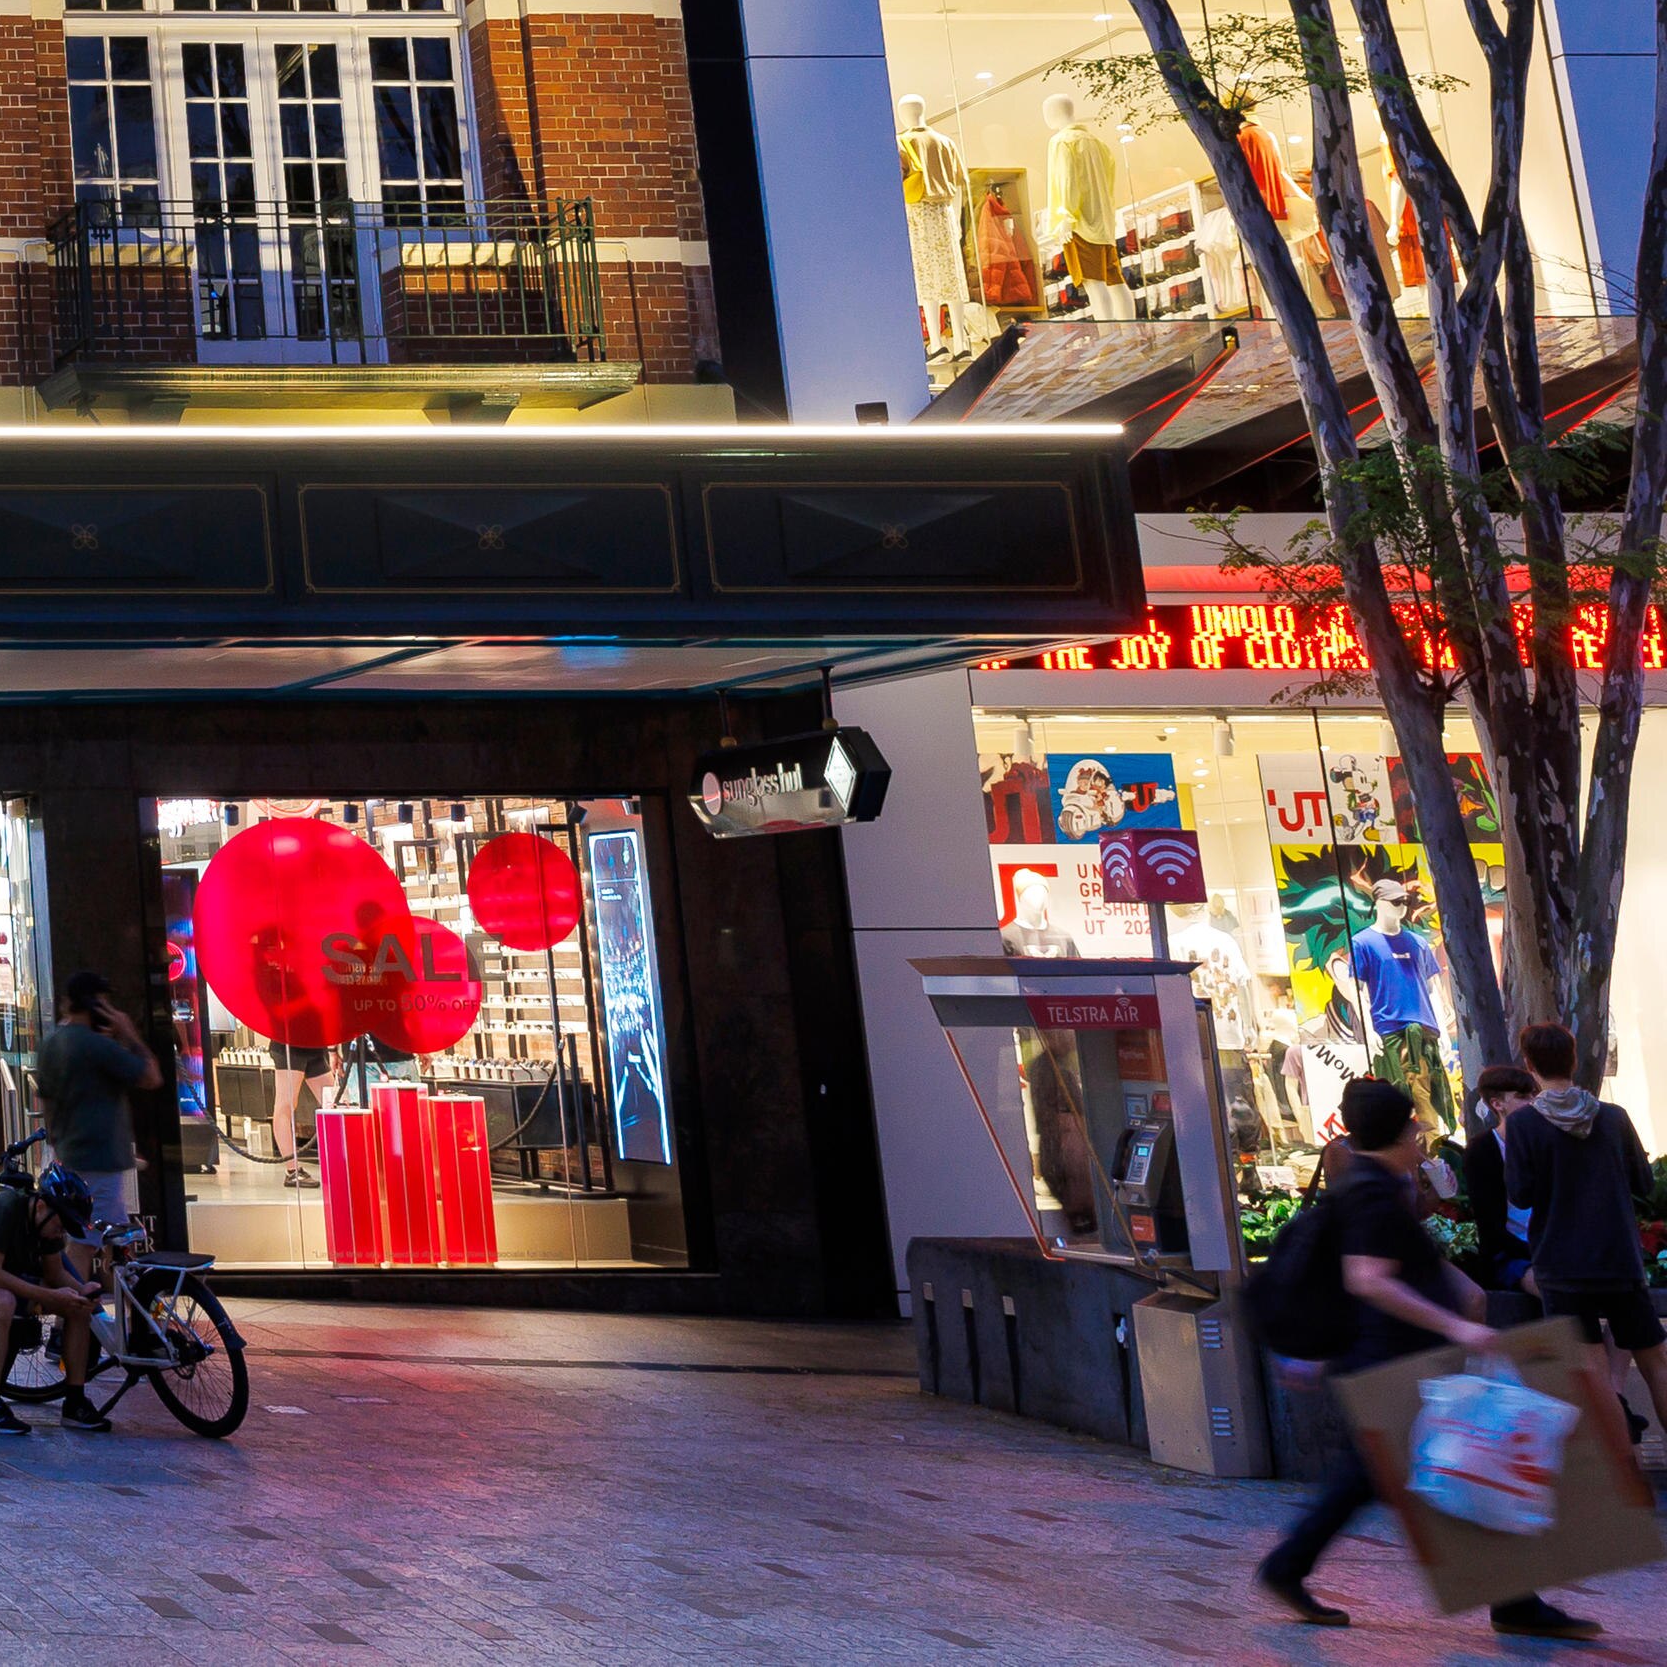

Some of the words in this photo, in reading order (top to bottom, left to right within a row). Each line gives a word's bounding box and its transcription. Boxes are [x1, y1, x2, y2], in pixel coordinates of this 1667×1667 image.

[1190, 605, 1296, 637] UNIQLO
[1111, 632, 1172, 670] JOY
[1192, 634, 1226, 669] OF
[722, 767, 779, 806] sunglass
[776, 762, 803, 794] hut
[1085, 920, 1105, 935] UT
[1125, 919, 1152, 935] 202
[321, 932, 508, 982] SALE
[354, 999, 369, 1012] UP
[377, 999, 397, 1012] TO
[400, 994, 447, 1013] 50%
[452, 1000, 480, 1012] OFF
[1047, 1006, 1109, 1023] TELSTRA
